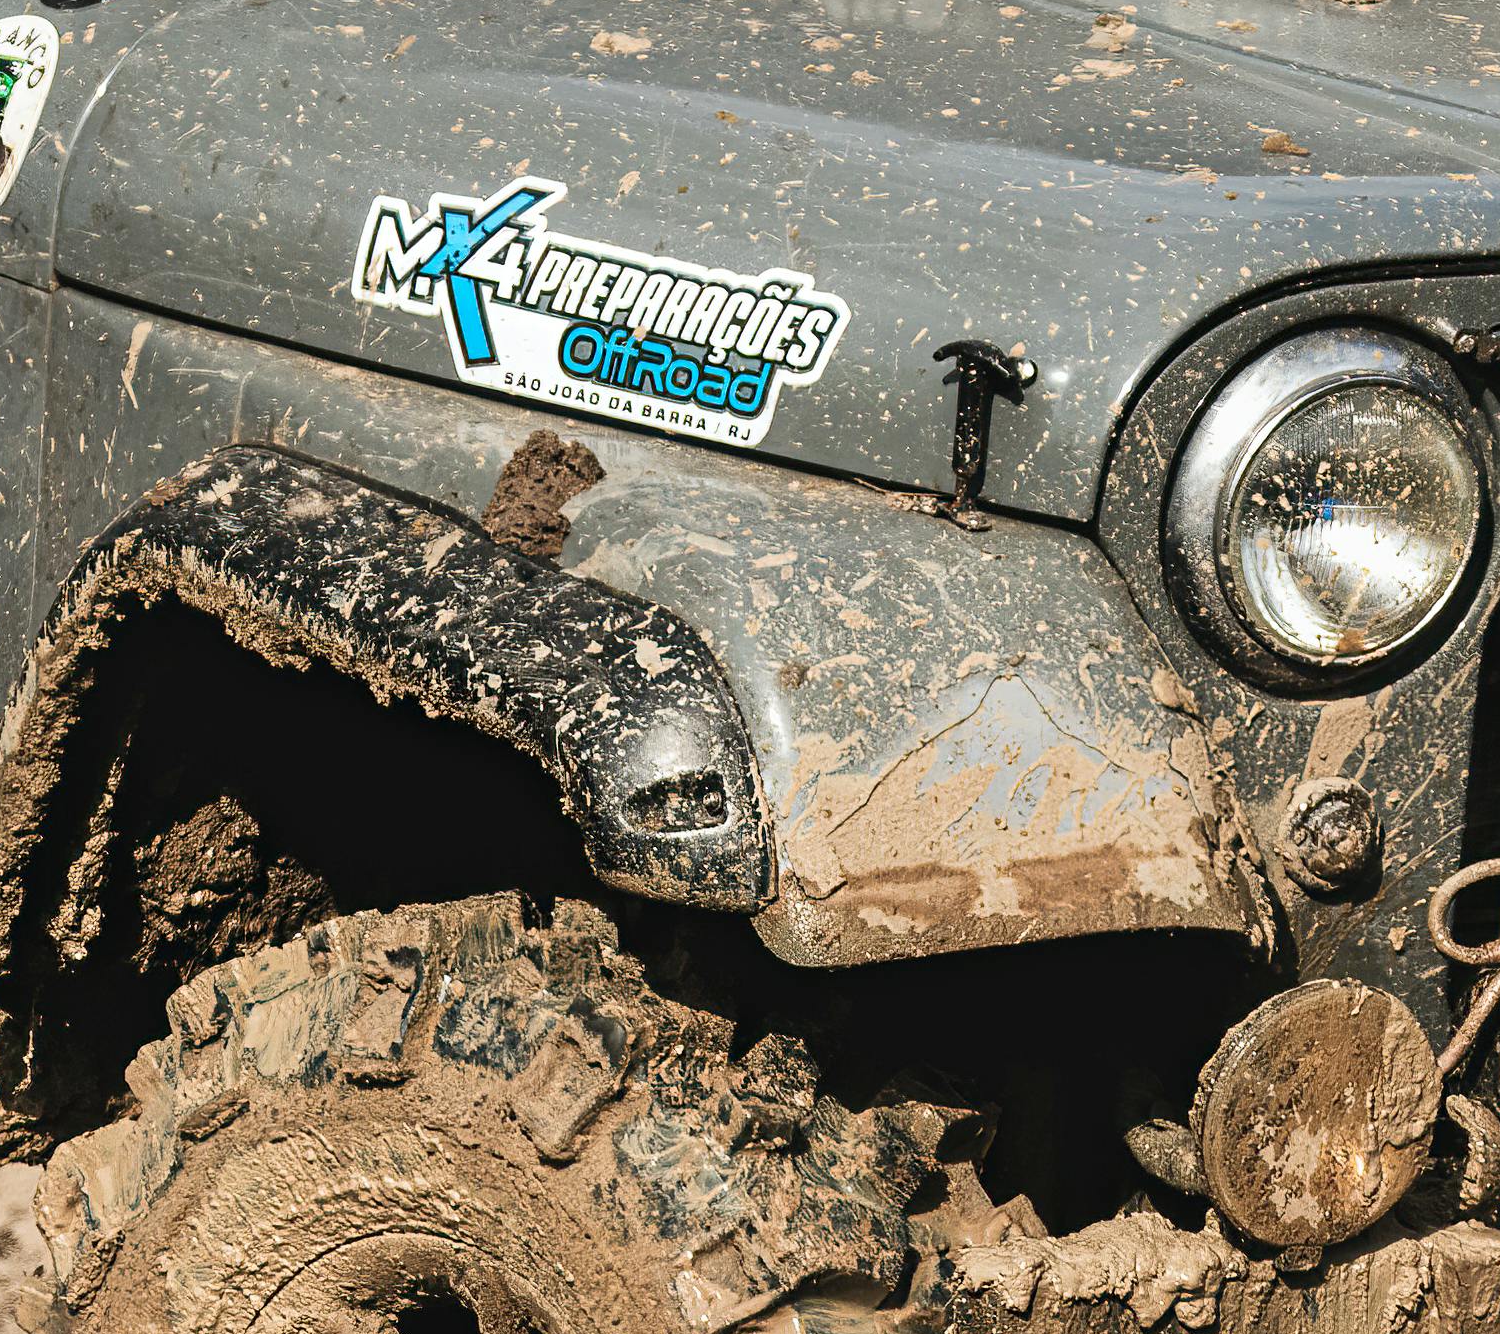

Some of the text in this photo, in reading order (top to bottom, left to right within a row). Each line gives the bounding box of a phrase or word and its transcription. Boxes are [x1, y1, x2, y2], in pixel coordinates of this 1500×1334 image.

[525, 249, 835, 368] PREPARAÇÕES
[608, 397, 633, 413] DA
[642, 405, 707, 431] BARRA
[728, 424, 751, 441] RJ
